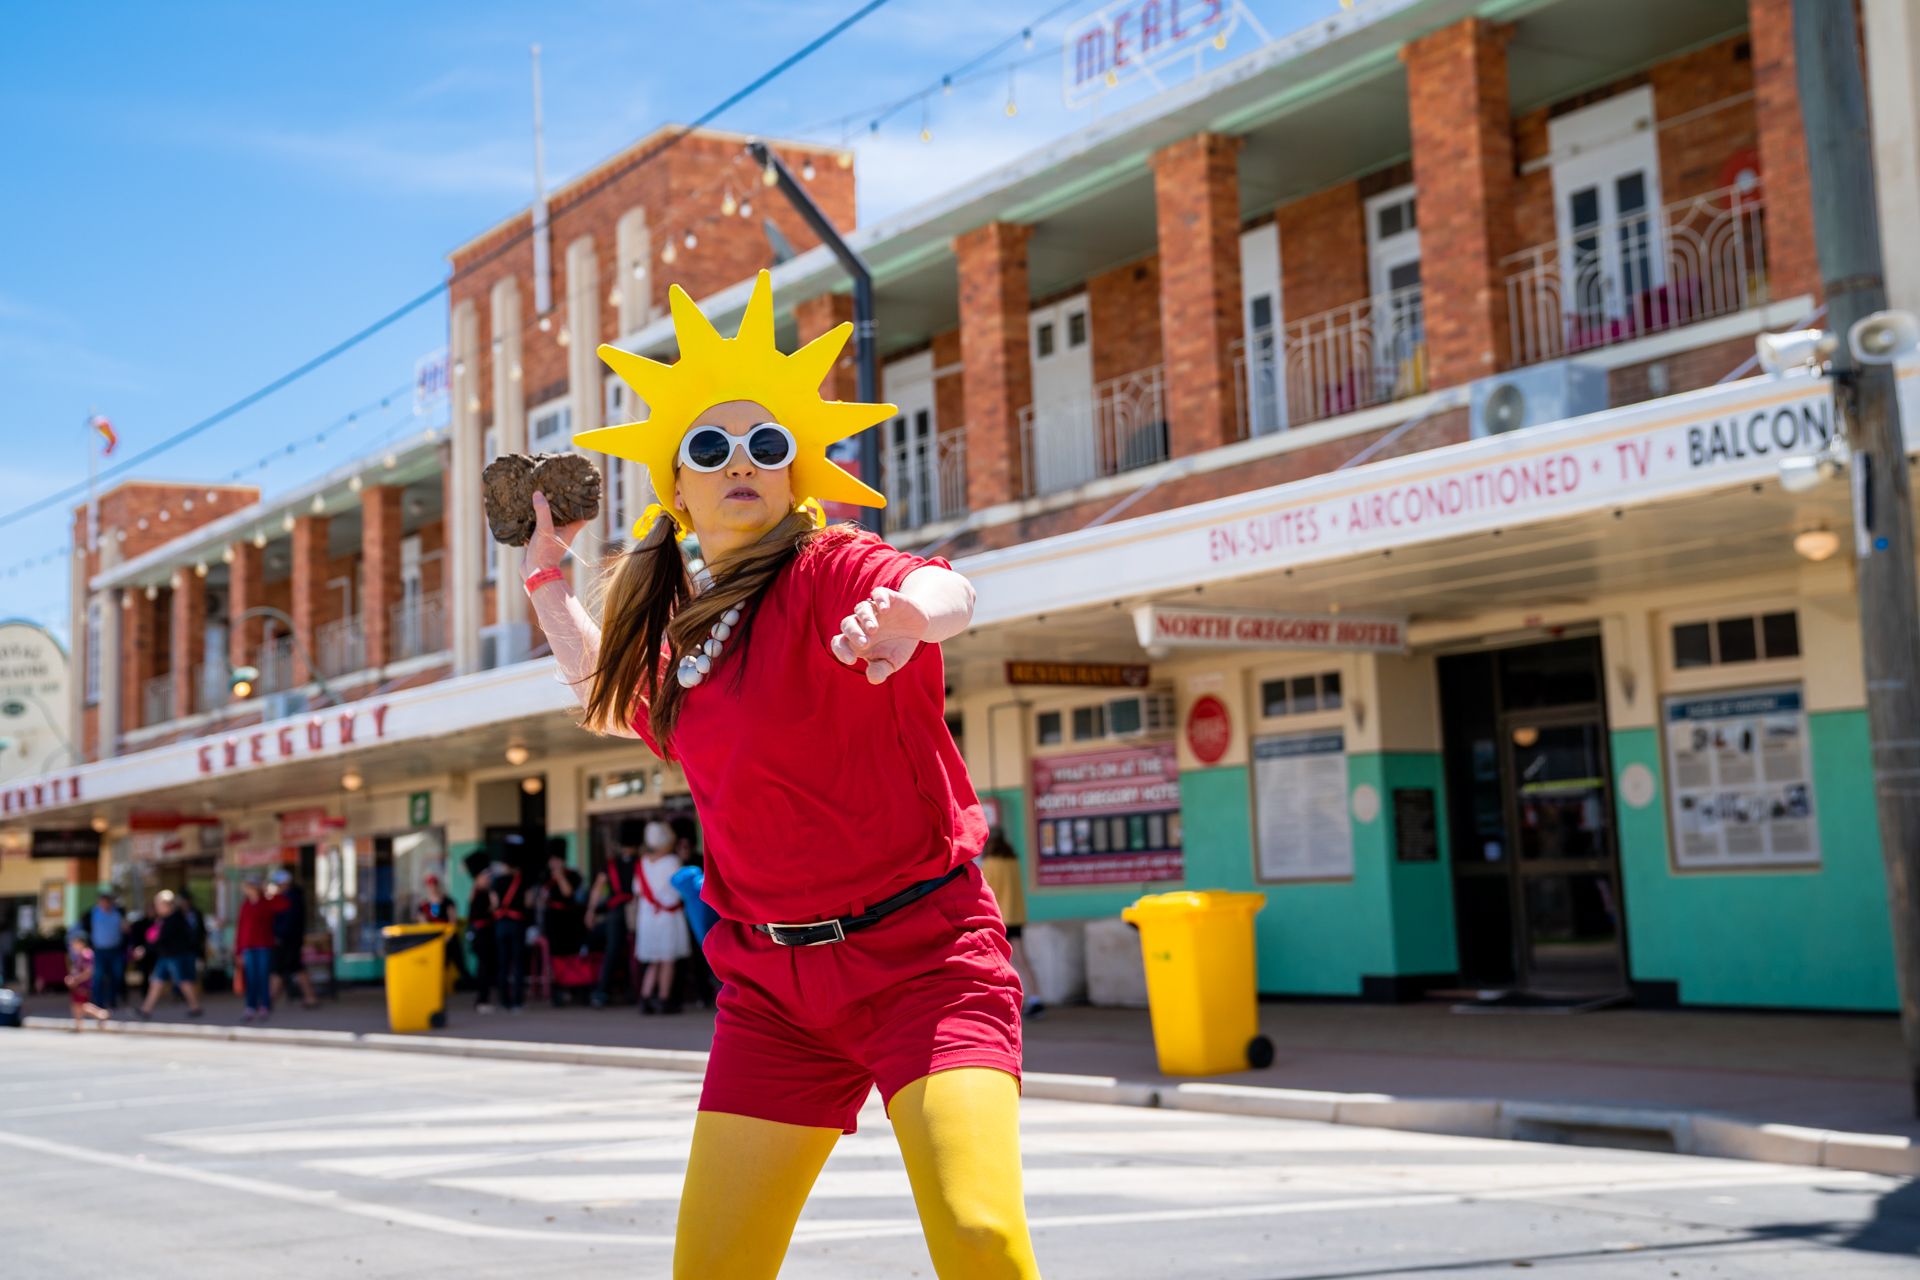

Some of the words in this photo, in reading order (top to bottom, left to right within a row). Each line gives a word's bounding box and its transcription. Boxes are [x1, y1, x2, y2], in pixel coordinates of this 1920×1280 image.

[1209, 507, 1320, 562] EN-SUITES
[1350, 455, 1581, 531] AIRCONDITIONED
[1615, 440, 1652, 481] TV
[1687, 401, 1829, 467] BALCON
[1155, 612, 1231, 641] NORTH
[1235, 616, 1331, 644] GREGORY
[1336, 620, 1400, 646] HOTEL
[198, 704, 389, 773] GREGORY
[1080, 787, 1138, 808] GREGORY
